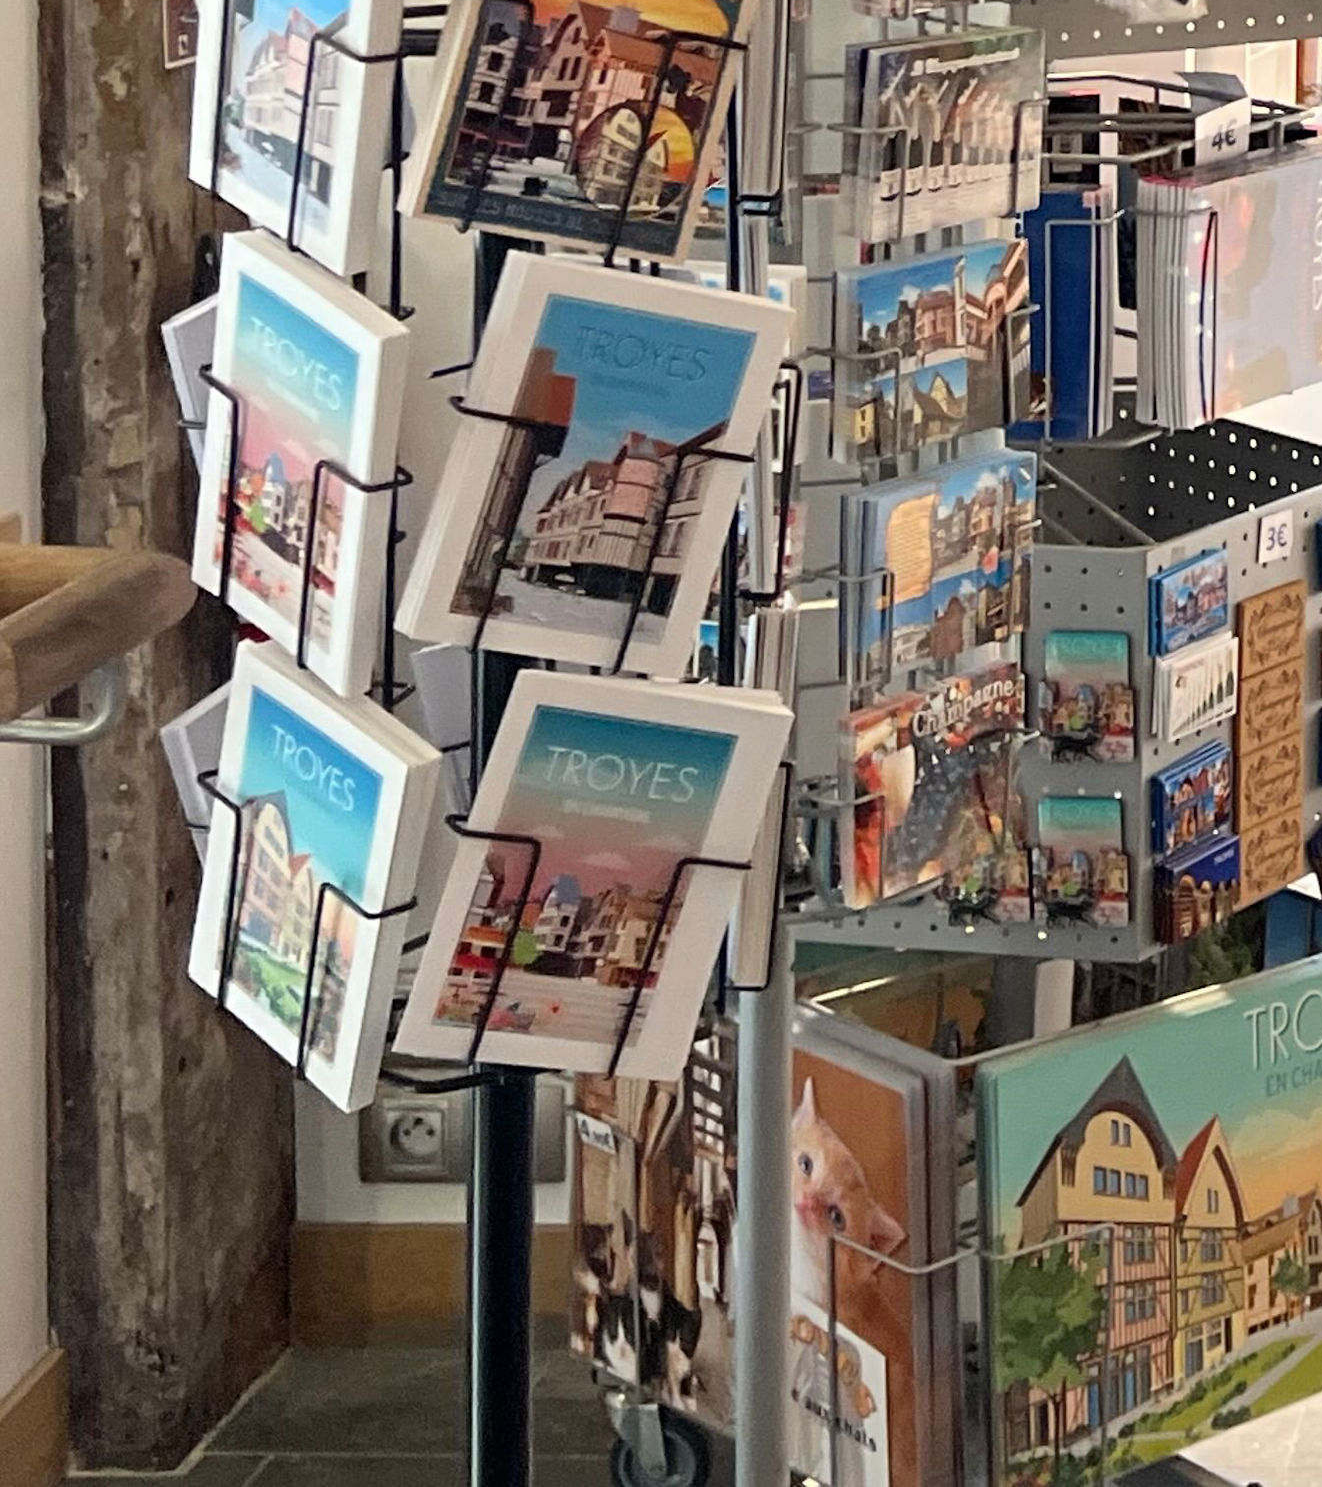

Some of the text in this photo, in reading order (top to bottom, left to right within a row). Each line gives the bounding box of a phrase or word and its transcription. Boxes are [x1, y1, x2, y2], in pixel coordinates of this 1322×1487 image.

[247, 315, 343, 413] TROYES
[575, 323, 711, 383] TROYES
[1265, 522, 1288, 551] 3€
[272, 724, 357, 812] TROYES
[545, 746, 699, 804] TROYES
[1265, 1072, 1288, 1097] EN
